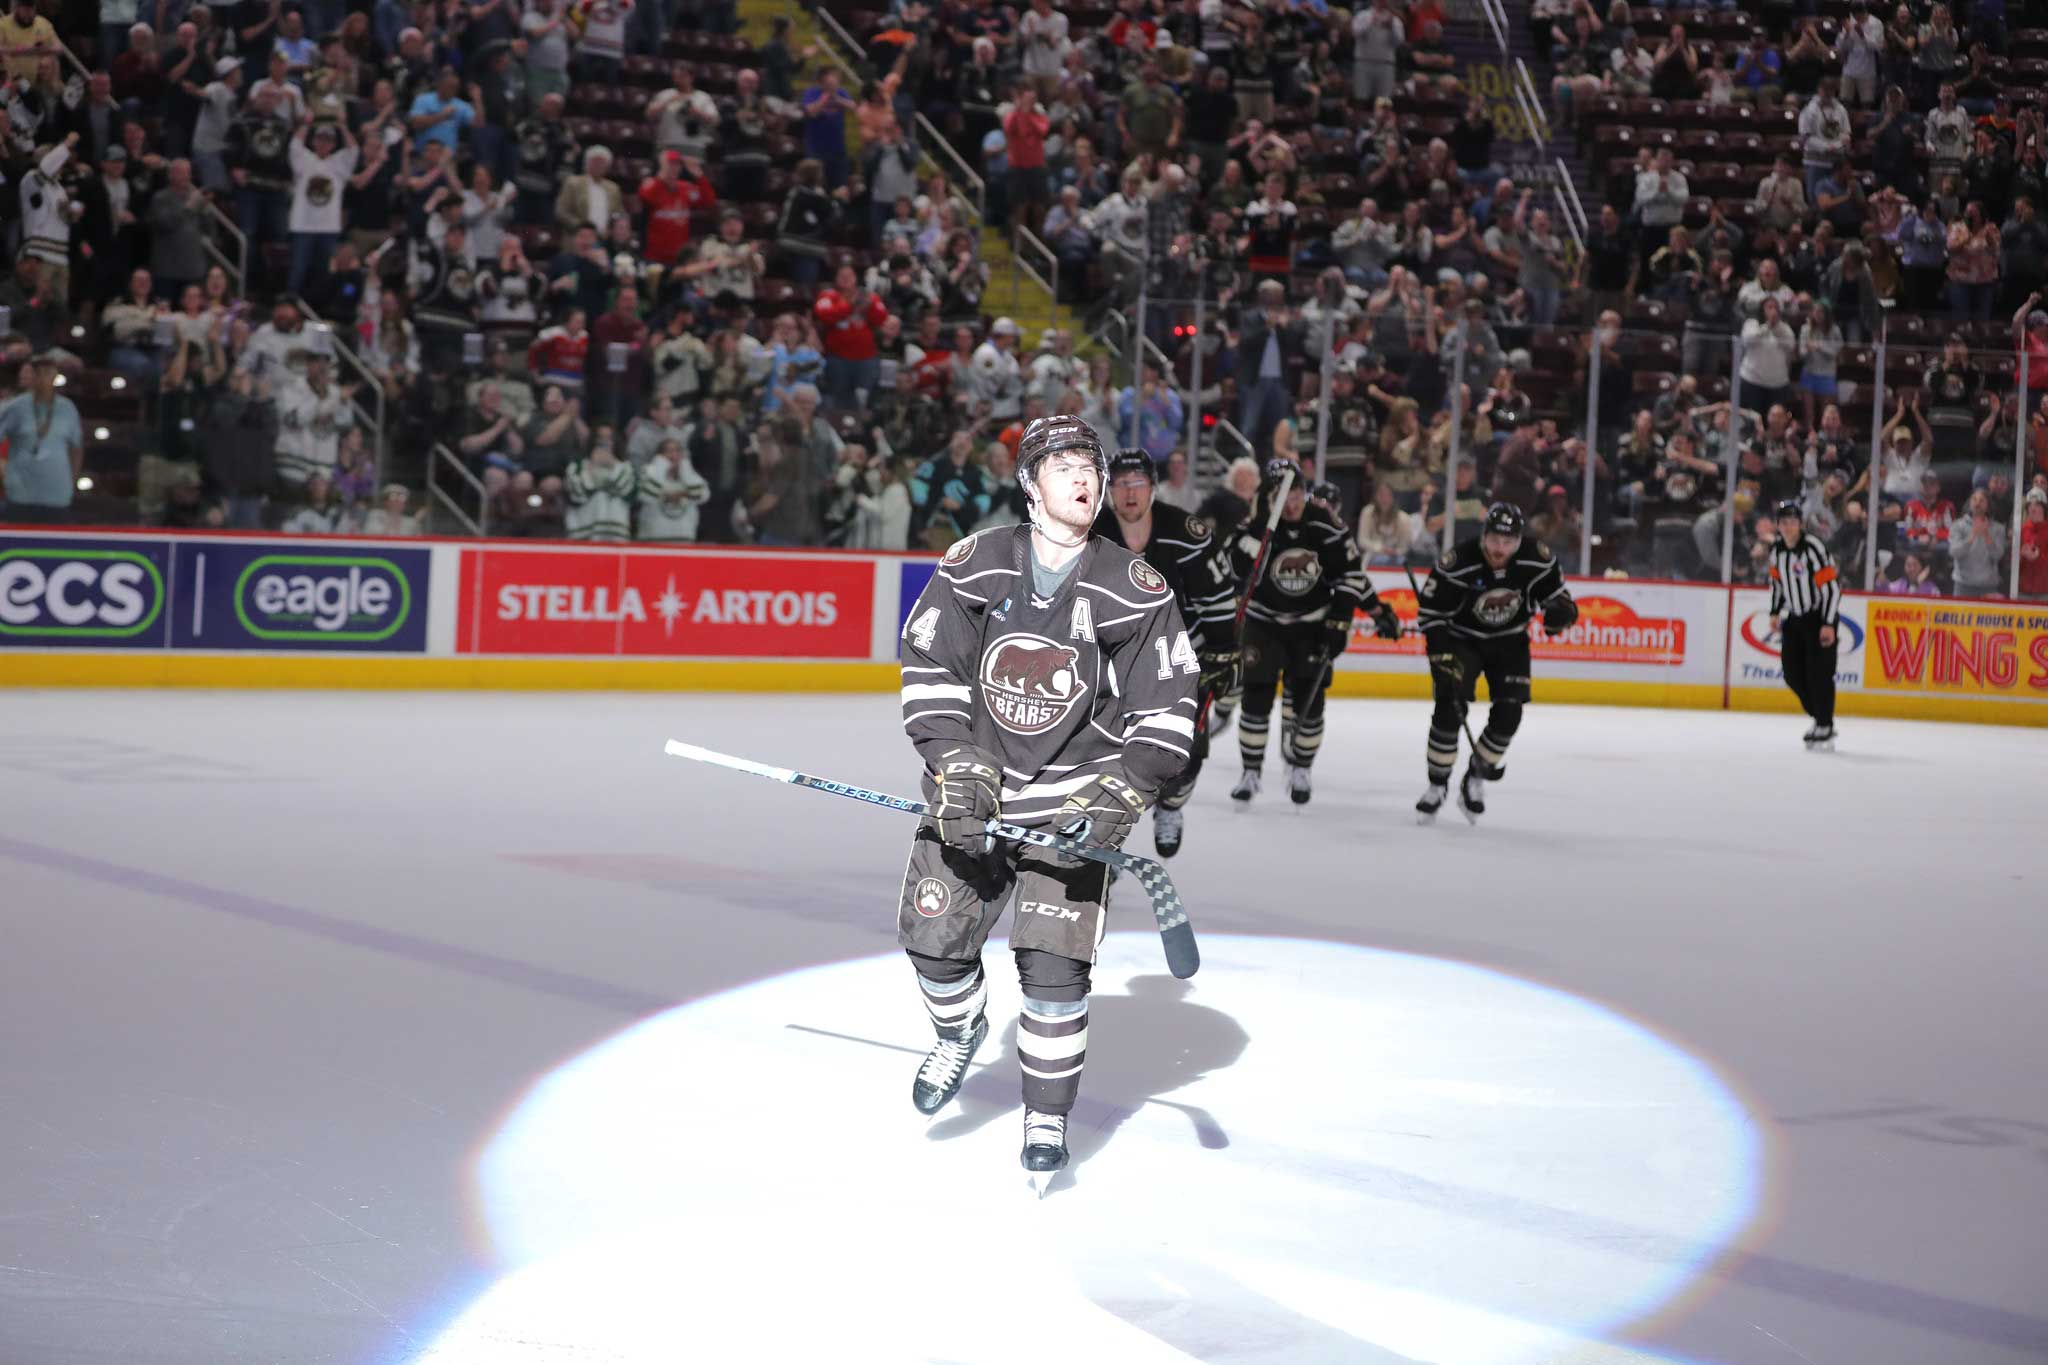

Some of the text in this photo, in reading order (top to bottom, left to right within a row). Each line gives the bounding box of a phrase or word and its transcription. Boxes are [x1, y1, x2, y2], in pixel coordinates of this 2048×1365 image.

[254, 566, 393, 631] eagle
[498, 584, 838, 627] STELLA ARTOIS
[1070, 596, 1096, 643] A
[1155, 630, 1201, 682] 14
[1874, 625, 2018, 687] WING
[995, 696, 1053, 726] BEARS
[1002, 691, 1048, 707] HERSHEY
[1020, 901, 1081, 922] CCM
